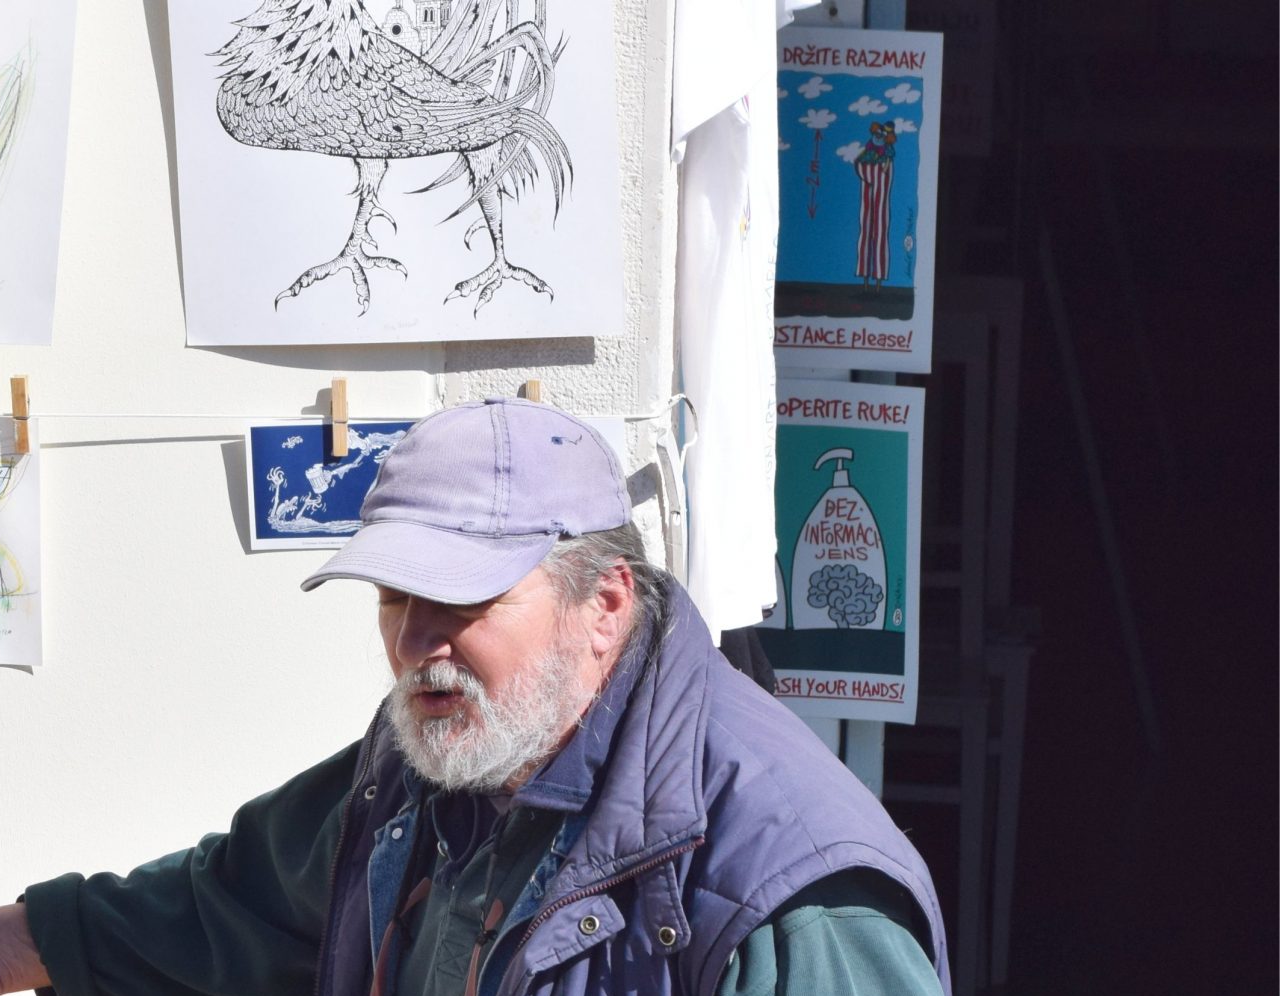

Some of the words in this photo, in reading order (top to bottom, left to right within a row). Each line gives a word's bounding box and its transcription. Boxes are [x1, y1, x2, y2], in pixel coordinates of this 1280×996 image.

[783, 44, 841, 66] DRŽITE
[846, 48, 926, 70] RAZMAK!
[774, 325, 847, 345] ISTANCE
[851, 328, 914, 349] please!
[858, 401, 910, 425] RUKE!
[815, 547, 868, 561] JENS
[774, 677, 802, 695] ASH
[852, 680, 906, 700] HANDS!
